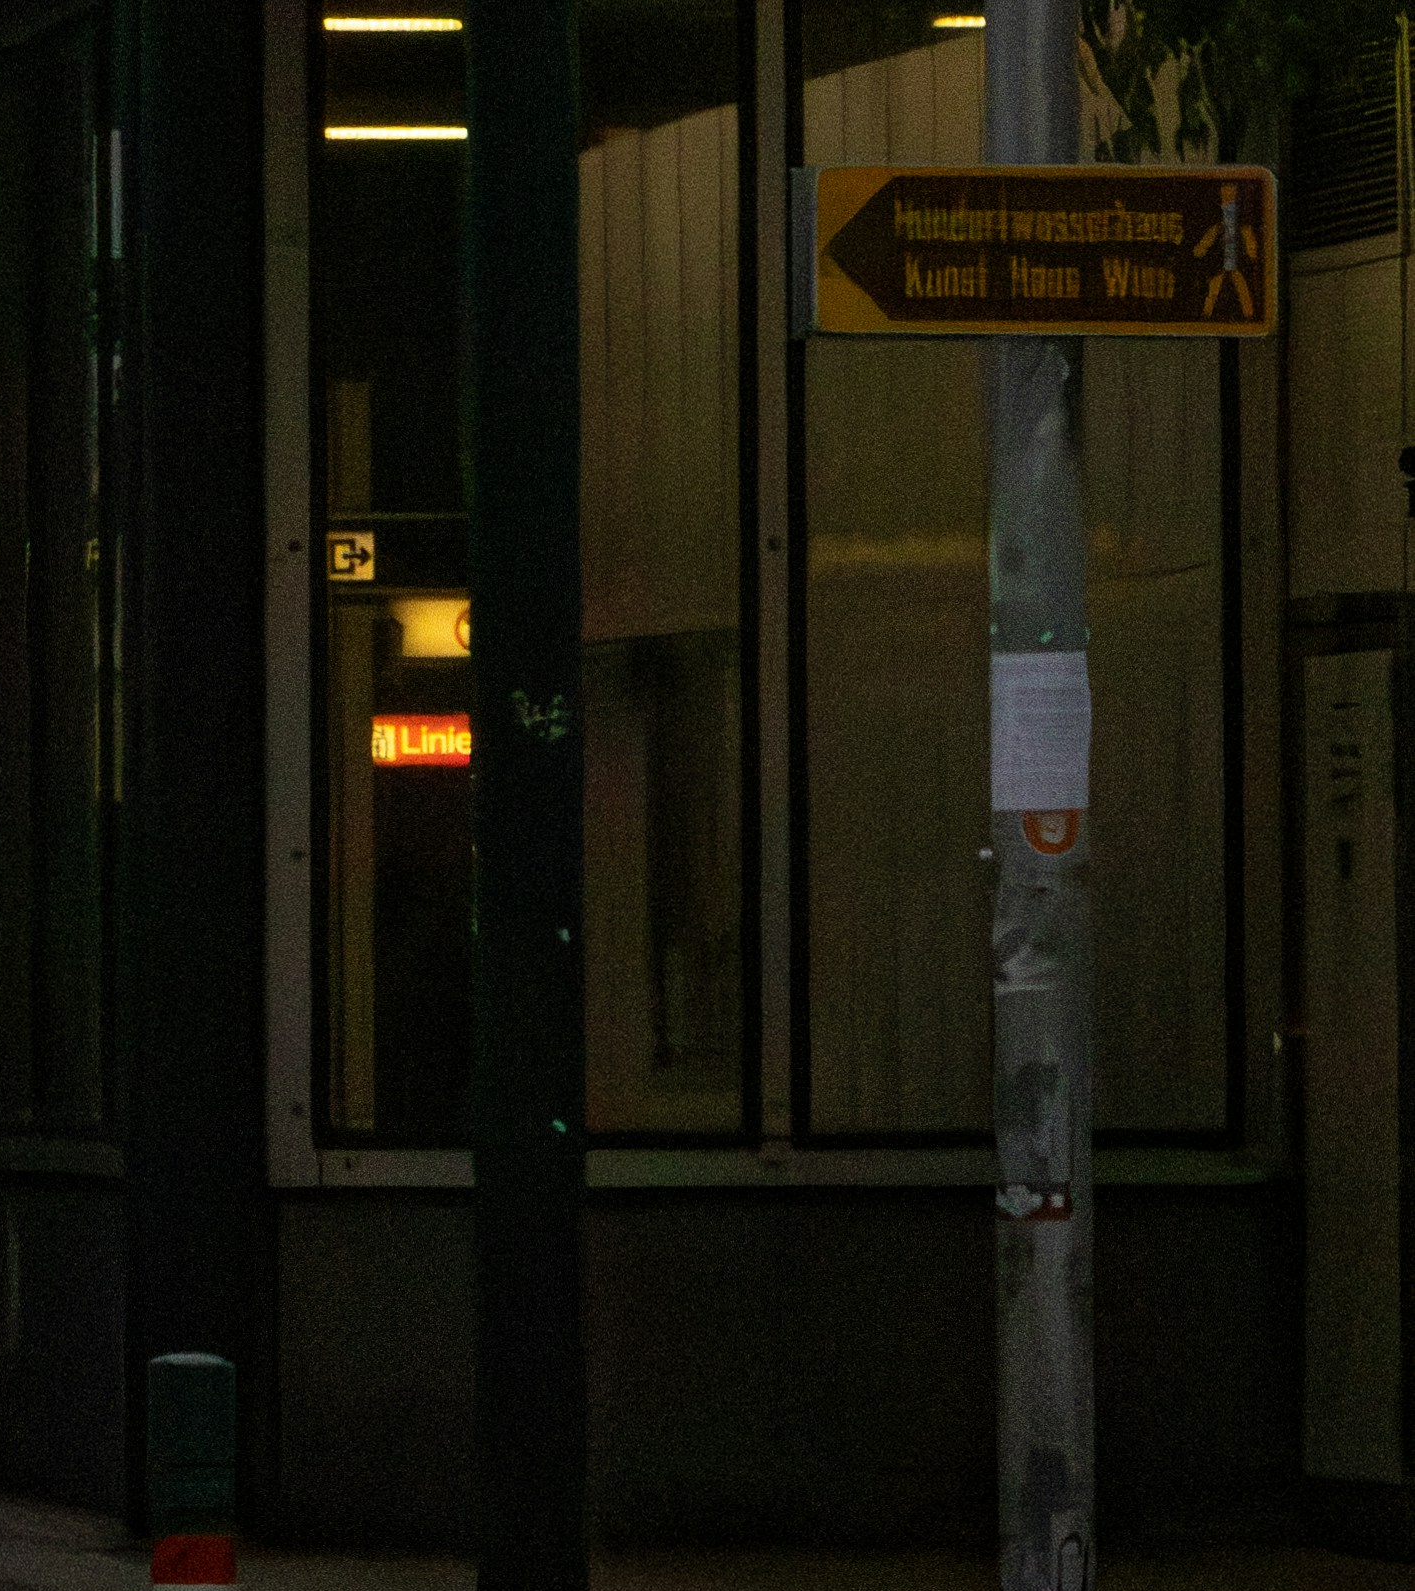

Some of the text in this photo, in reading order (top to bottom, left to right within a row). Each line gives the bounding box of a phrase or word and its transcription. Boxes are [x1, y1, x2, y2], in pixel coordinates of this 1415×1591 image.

[892, 194, 1186, 246] Hundertwasserhaus
[903, 250, 1177, 300] Kunst Haus Wien
[400, 724, 473, 756] Linie
